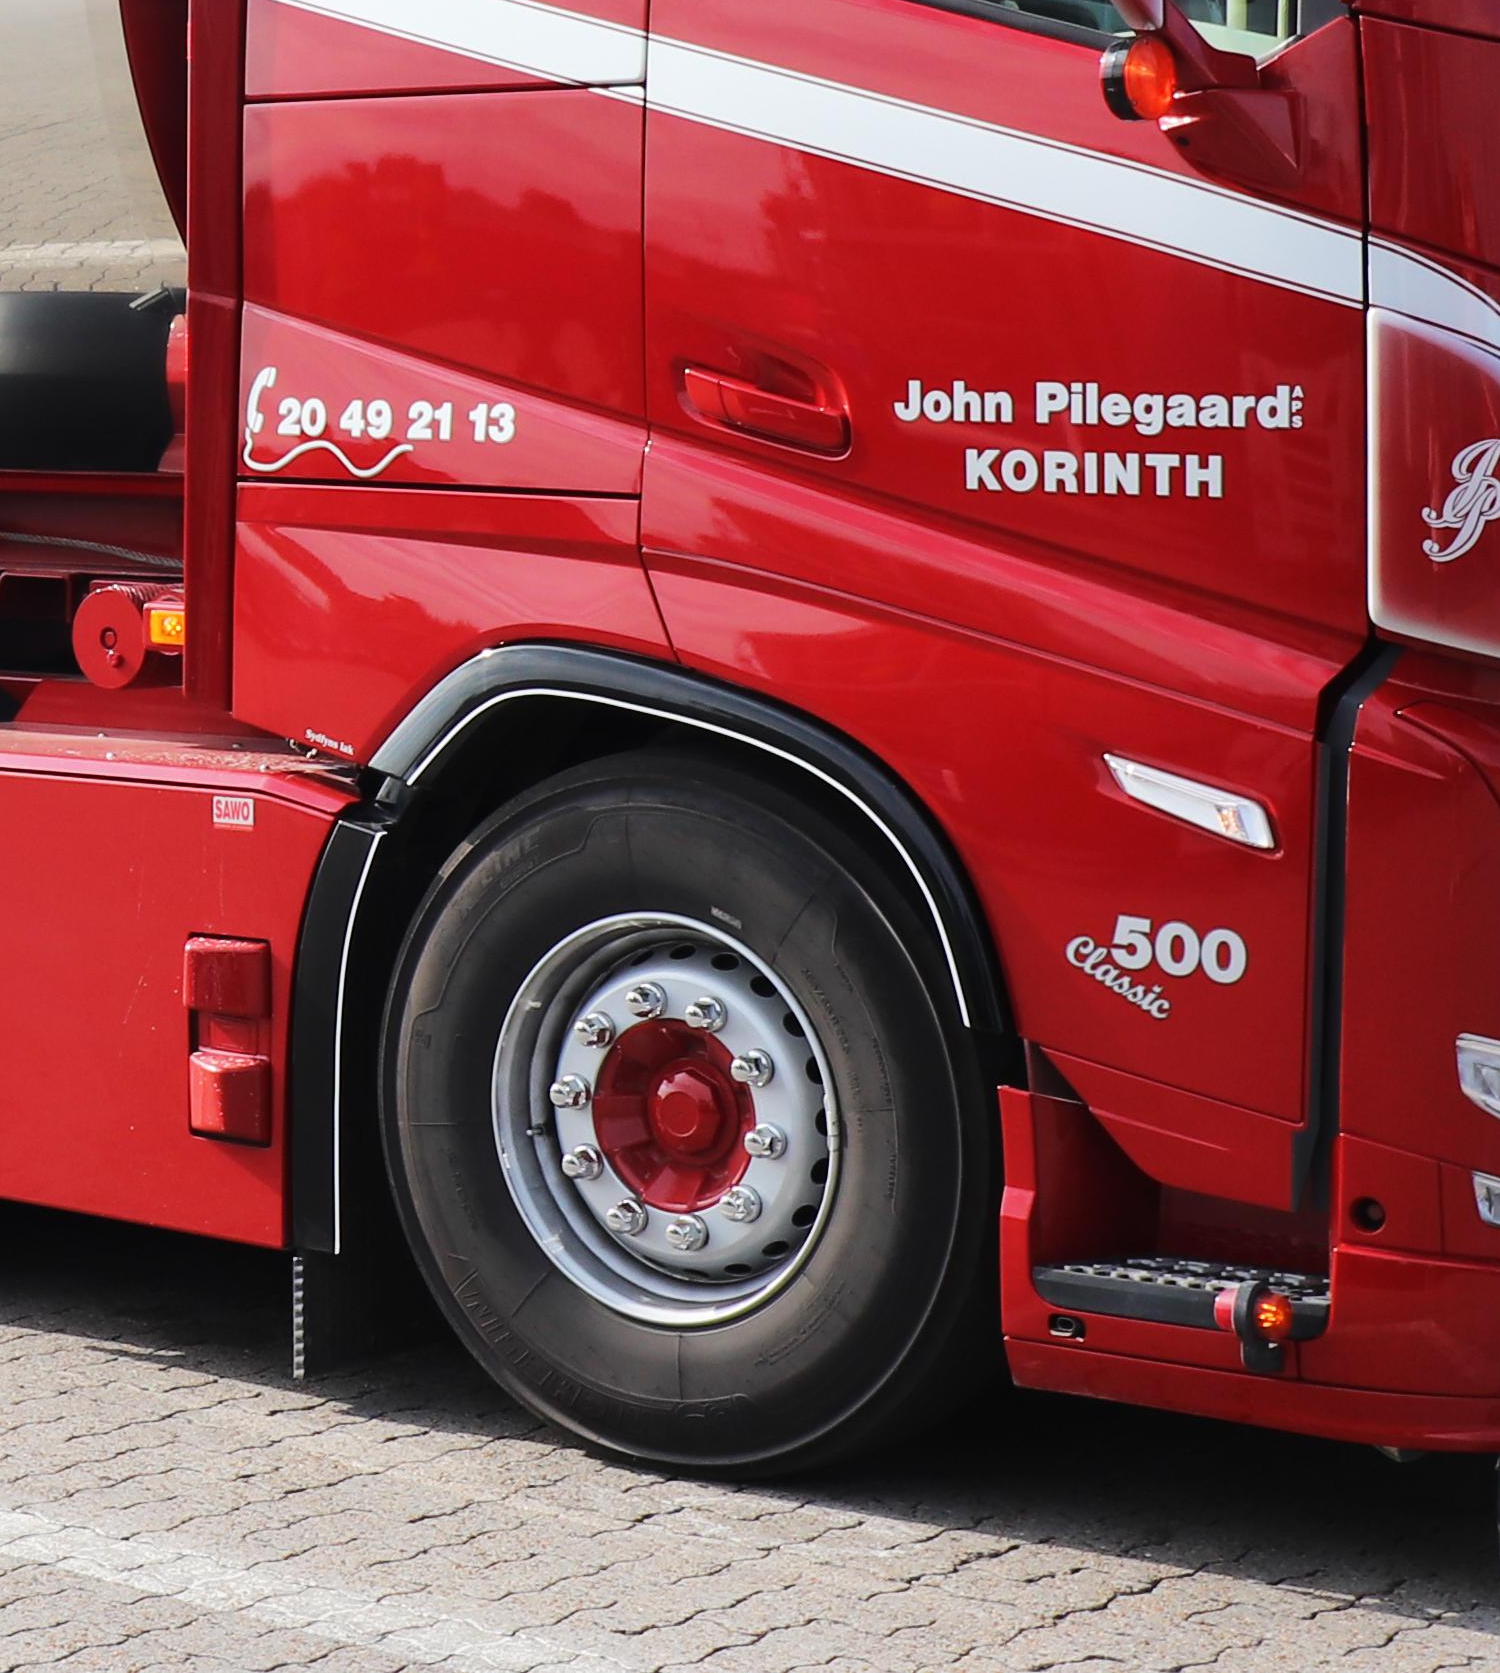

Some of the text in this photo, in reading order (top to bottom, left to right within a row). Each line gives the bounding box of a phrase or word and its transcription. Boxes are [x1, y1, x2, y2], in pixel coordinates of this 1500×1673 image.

[277, 397, 516, 444] 20 49 21 13
[893, 380, 1013, 425] John
[1035, 382, 1291, 435] Pilegaard
[964, 449, 1223, 499] KORINTH
[215, 798, 250, 822] SAWO
[1110, 914, 1247, 984] 500
[1065, 935, 1171, 1019] Classic
